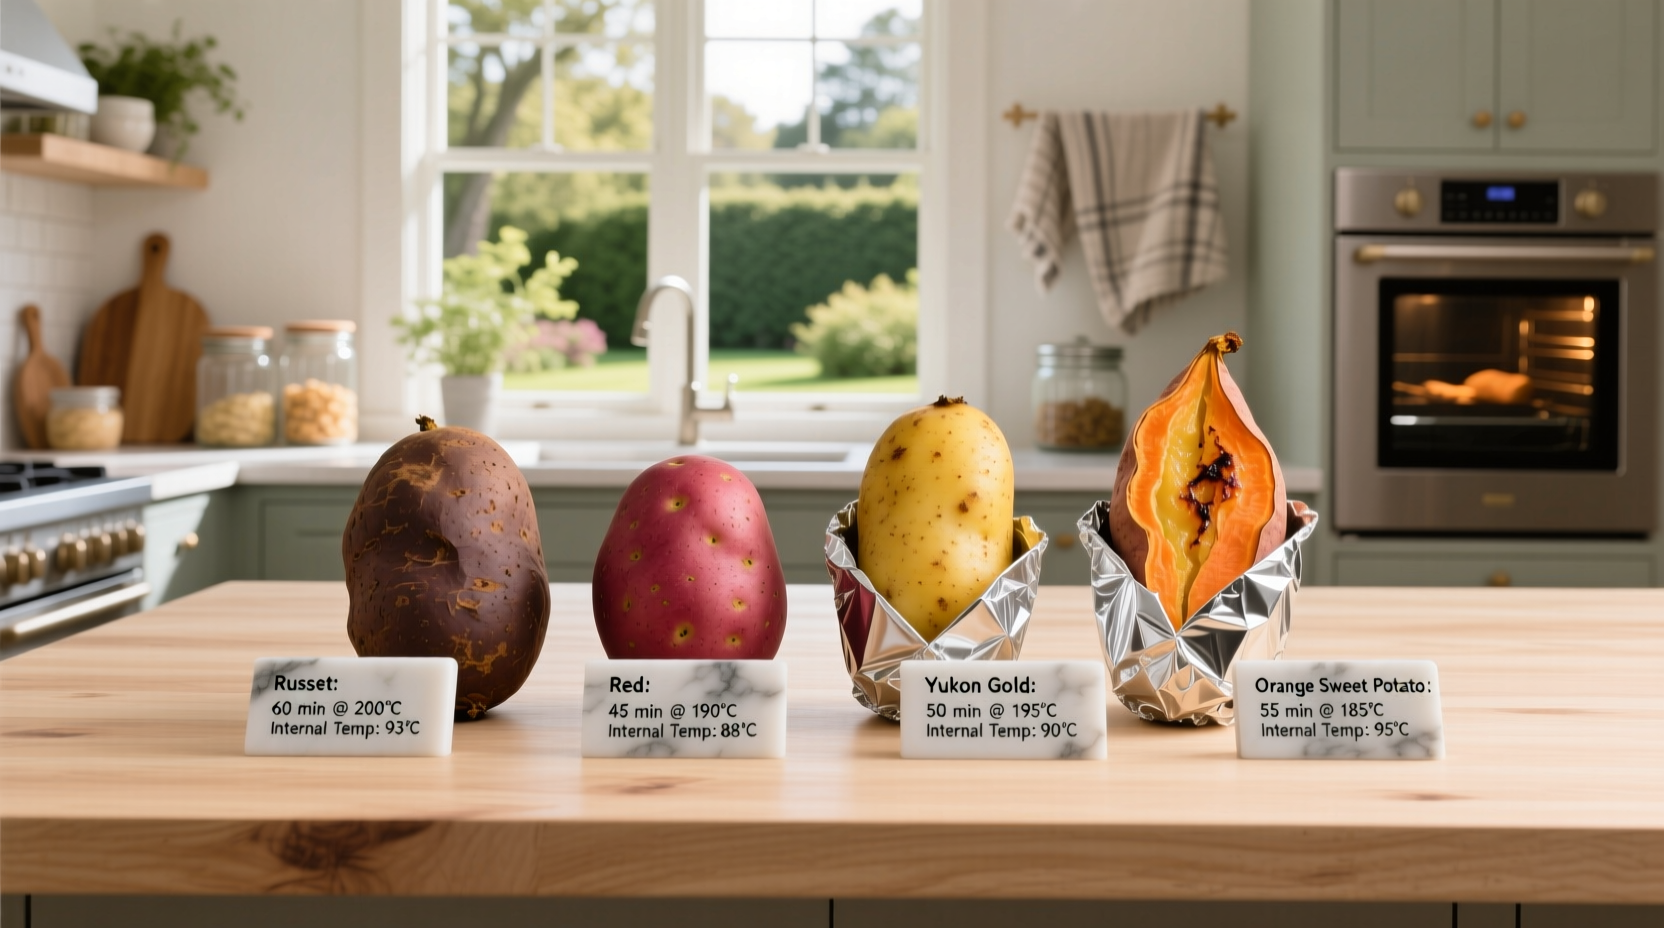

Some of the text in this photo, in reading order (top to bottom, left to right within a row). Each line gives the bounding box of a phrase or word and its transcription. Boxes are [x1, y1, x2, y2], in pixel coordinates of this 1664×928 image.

[274, 675, 338, 691] Russet:
[610, 676, 650, 692] Red:
[925, 677, 1036, 693] Yukon Gold:
[1256, 678, 1431, 697] Orange Sweet Potato:
[272, 701, 402, 716] 60 min @ 200°C
[609, 703, 737, 719] 45 min @ 190°C
[927, 703, 1057, 719] 50 min @ 195°C
[1261, 702, 1384, 718] 55 min @ 185°C
[271, 720, 420, 739] Internal Temp: 93°C
[609, 722, 757, 741] Internal Temp: 88°C
[927, 722, 1077, 741] Internal Temp: 90°C
[1262, 721, 1409, 741] Internal Temp: 95°C
